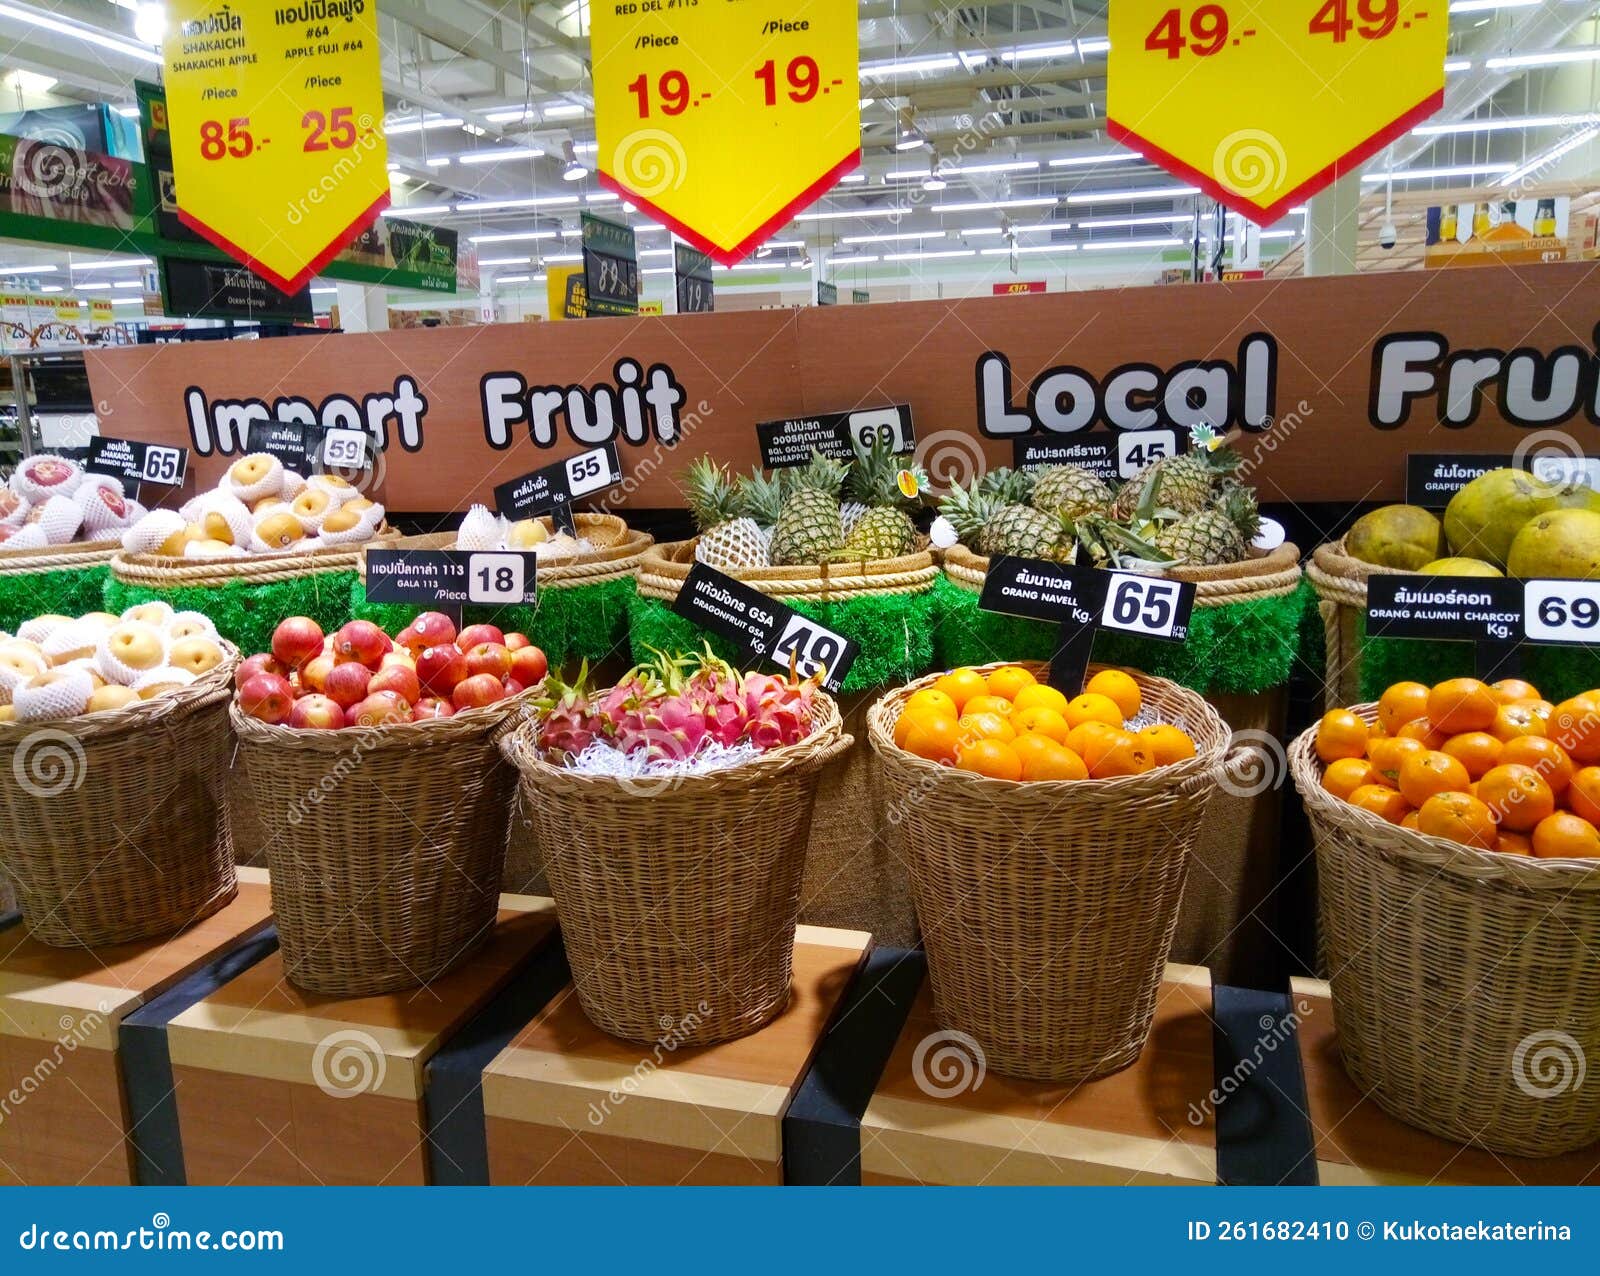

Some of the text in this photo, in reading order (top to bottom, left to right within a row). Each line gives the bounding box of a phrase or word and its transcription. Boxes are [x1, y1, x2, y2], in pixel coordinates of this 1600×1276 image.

[615, 3, 637, 16] RED
[305, 26, 330, 40] #64
[762, 18, 810, 35] /Piece
[284, 39, 364, 60] APPLE FUJI #64
[634, 34, 679, 49] /Piece
[172, 53, 259, 73] SHAKAICHI APPLE
[304, 75, 342, 89] /Piece
[201, 86, 238, 101] /Piece
[976, 332, 1279, 440] Local
[480, 356, 687, 451] Fruit
[818, 439, 843, 450] SWEET
[858, 423, 896, 449] 69
[265, 442, 305, 453] SNOW PEAR
[328, 439, 359, 460] 59
[769, 452, 810, 464] PINEAPPLE
[1125, 443, 1166, 469] 45
[145, 450, 176, 480] 65
[572, 456, 601, 482] 55
[514, 489, 550, 509] HONEY PEAR
[371, 558, 464, 576] แอปเปิ้ลกาล่า 113
[397, 579, 439, 588] GALA 113
[477, 566, 514, 593] 18
[1015, 567, 1073, 591] ส้มนาเวล
[434, 589, 467, 601] /Piece
[695, 579, 774, 628] แก้วมังกร GSA
[1001, 586, 1079, 607] ORANG NAVELL
[1112, 580, 1173, 629] 65
[692, 596, 765, 639] DRAGONFRUIT GSA
[1369, 608, 1521, 623] ORANG ALUMNI CHARCOT
[1537, 596, 1600, 629] 69
[777, 626, 839, 677] 49
